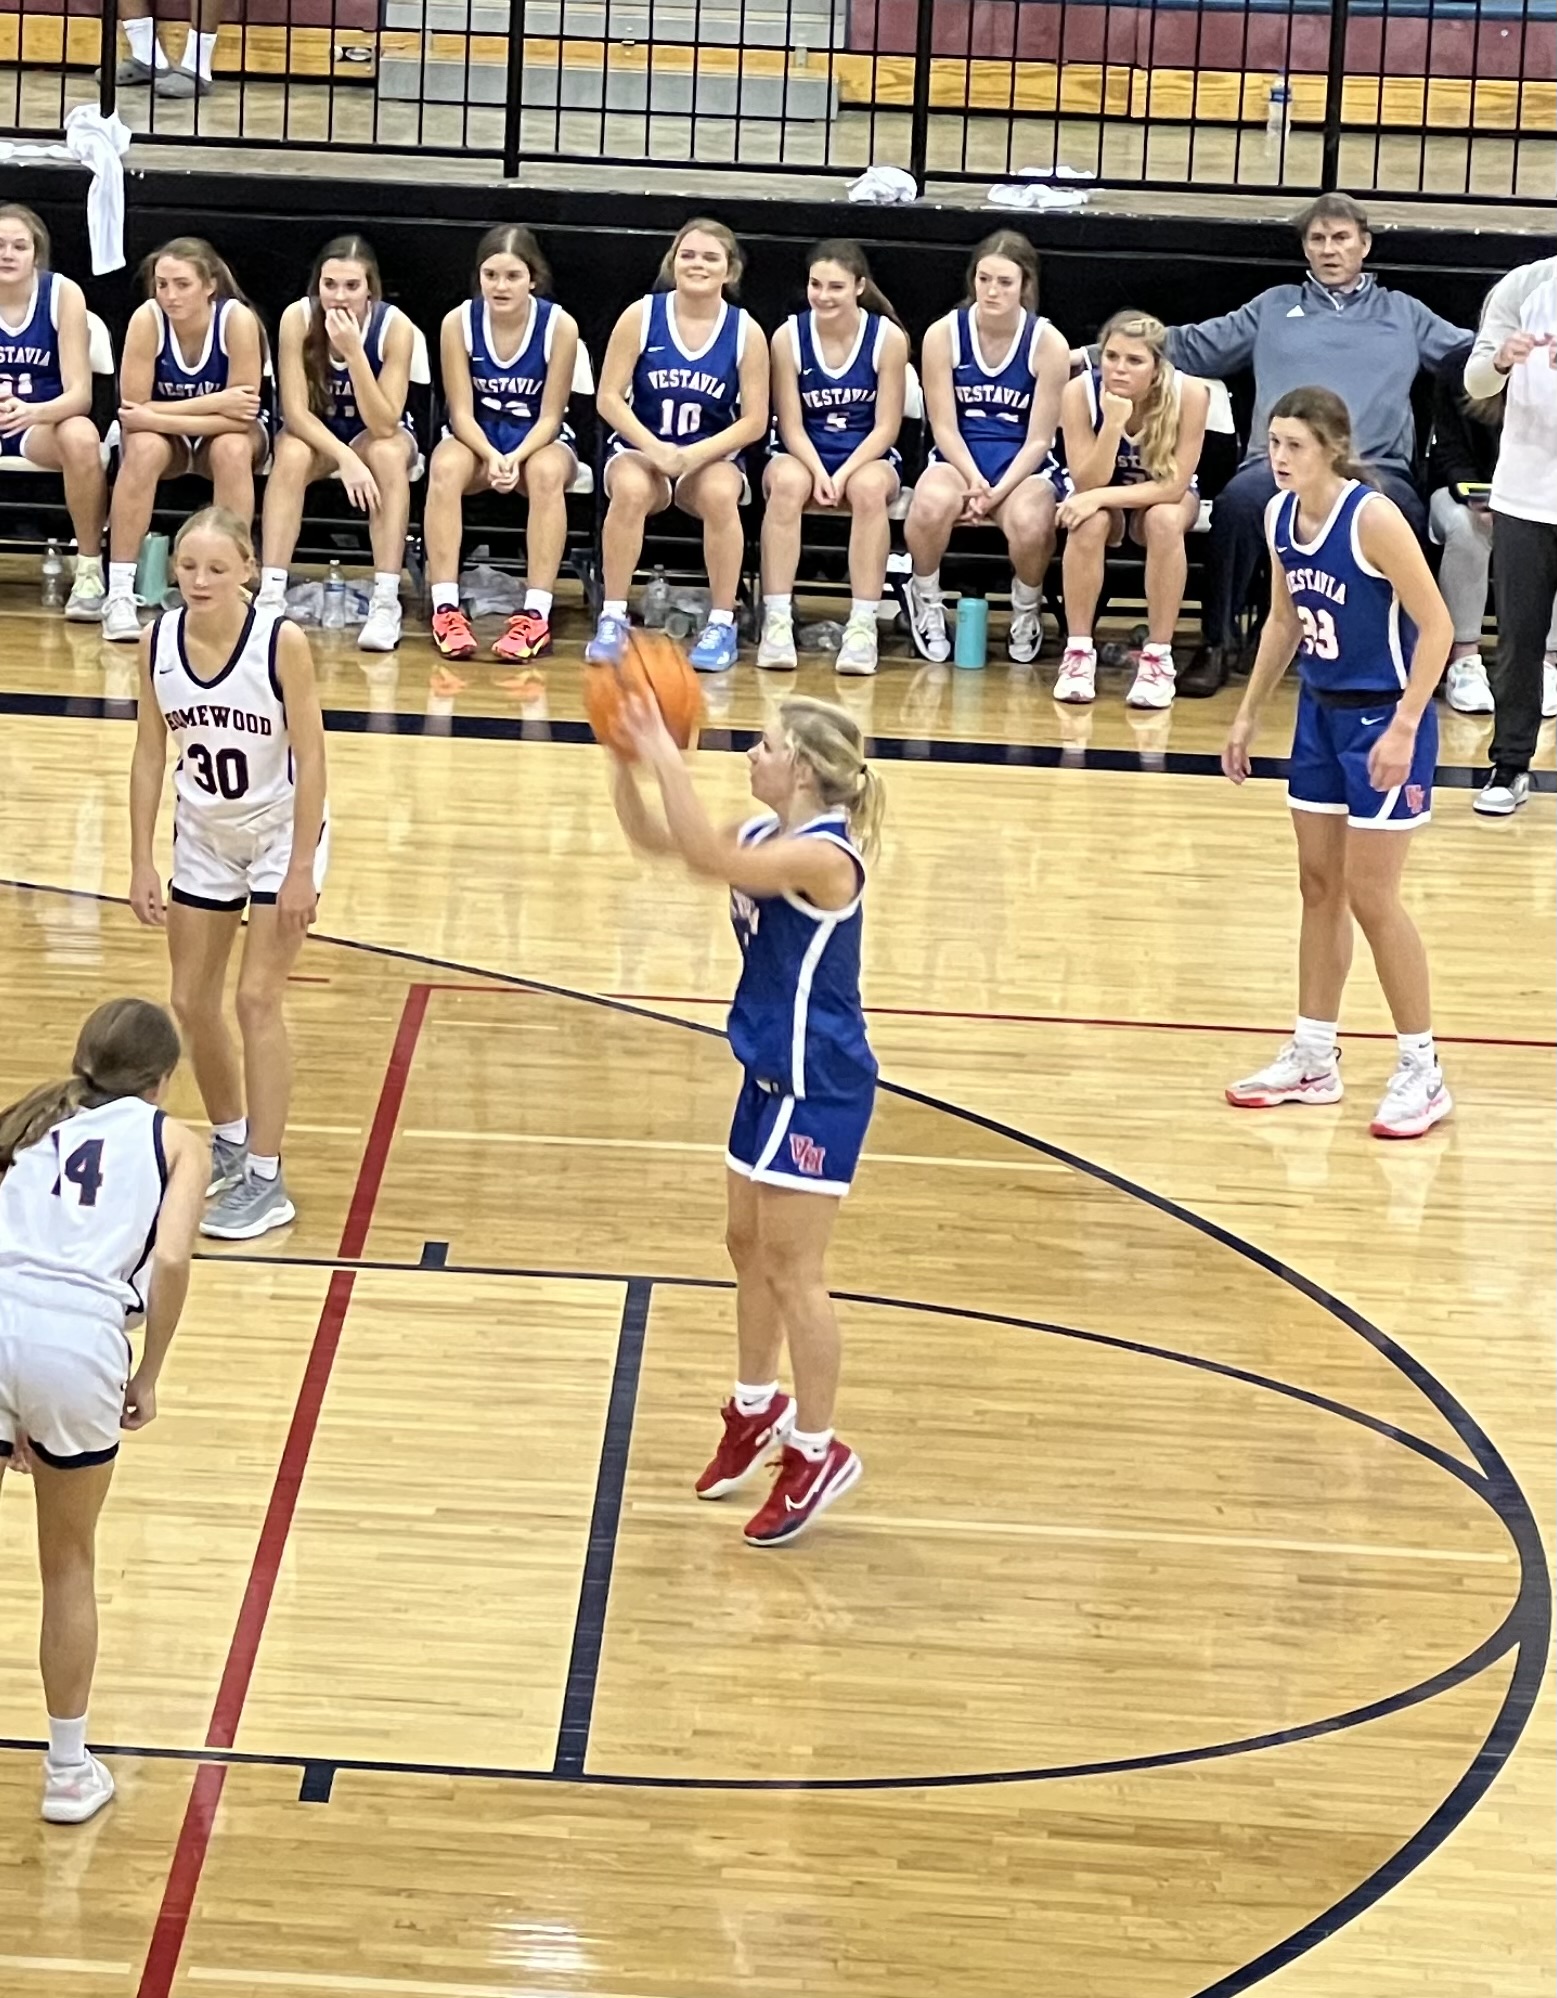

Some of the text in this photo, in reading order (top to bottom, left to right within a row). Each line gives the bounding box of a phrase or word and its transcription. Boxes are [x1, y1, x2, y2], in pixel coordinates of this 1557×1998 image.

[647, 368, 726, 399] VESTAVIA
[802, 388, 877, 408] VESTAVIA
[954, 384, 1030, 409] VESTAVIA
[659, 398, 702, 437] 10
[1297, 605, 1339, 660] 33
[187, 743, 249, 800] 30
